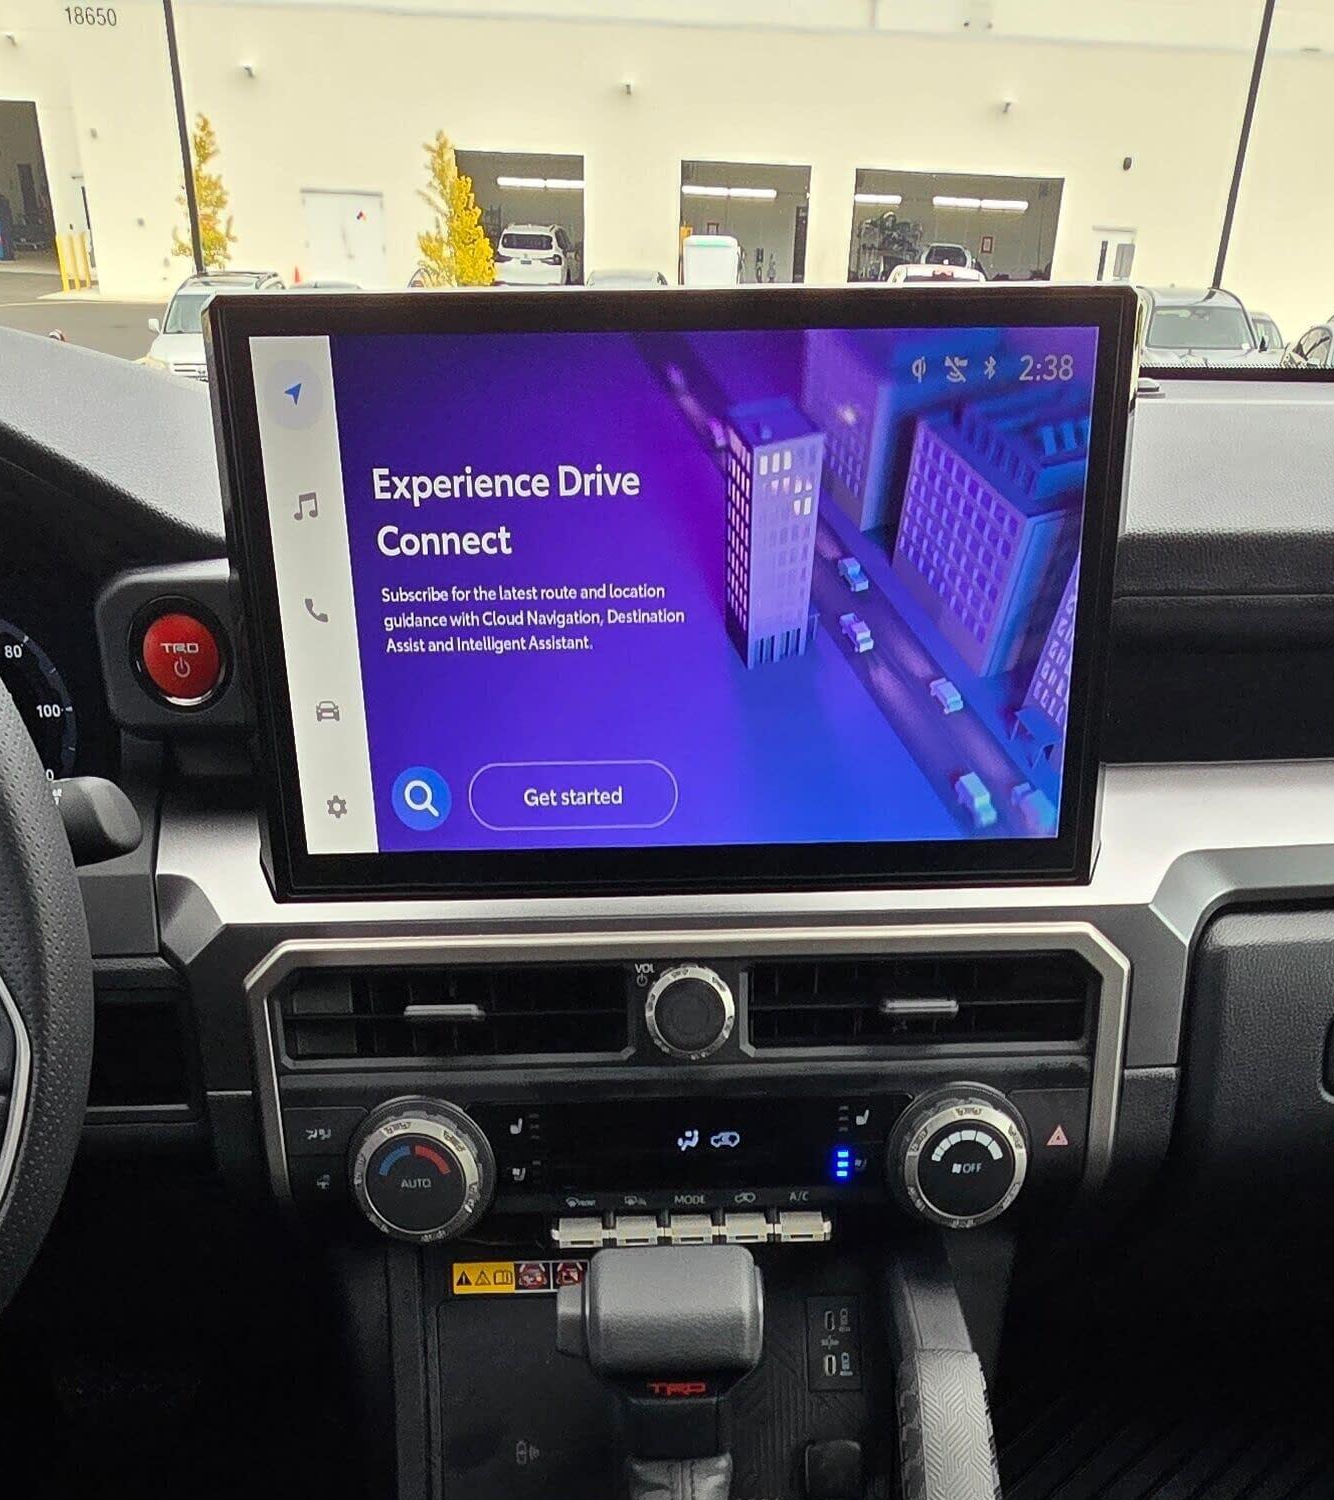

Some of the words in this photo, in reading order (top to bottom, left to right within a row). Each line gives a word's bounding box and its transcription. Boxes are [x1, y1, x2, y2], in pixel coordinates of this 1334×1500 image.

[65, 6, 117, 27] 18650
[1019, 354, 1075, 381] 2:38
[372, 466, 550, 507] Experience
[558, 464, 641, 496] Drive
[377, 525, 513, 556] Connect
[381, 586, 449, 602] Subscribe
[451, 585, 470, 602] for
[473, 585, 497, 600] the
[499, 585, 538, 600] latest
[541, 585, 577, 600] route
[580, 583, 606, 599] and
[609, 583, 665, 599] location
[384, 612, 447, 631] guidance
[450, 611, 480, 627] with
[482, 610, 524, 626] Cloud
[527, 609, 604, 628] Navigation,
[607, 608, 685, 624] Destination
[160, 643, 199, 653] TRD
[386, 637, 425, 653] Assist
[428, 637, 454, 652] and
[457, 636, 526, 654] Intelligent
[528, 635, 593, 651] Assistant.
[4, 645, 22, 659] 80
[36, 704, 61, 718] 100
[524, 788, 558, 807] Get
[561, 785, 623, 806] started
[635, 964, 655, 974] VOL
[962, 1163, 982, 1174] OFF
[401, 1178, 432, 1189] AUTO
[674, 1195, 706, 1205] MODE
[789, 1190, 809, 1201] A/C
[648, 1382, 706, 1396] TRD
